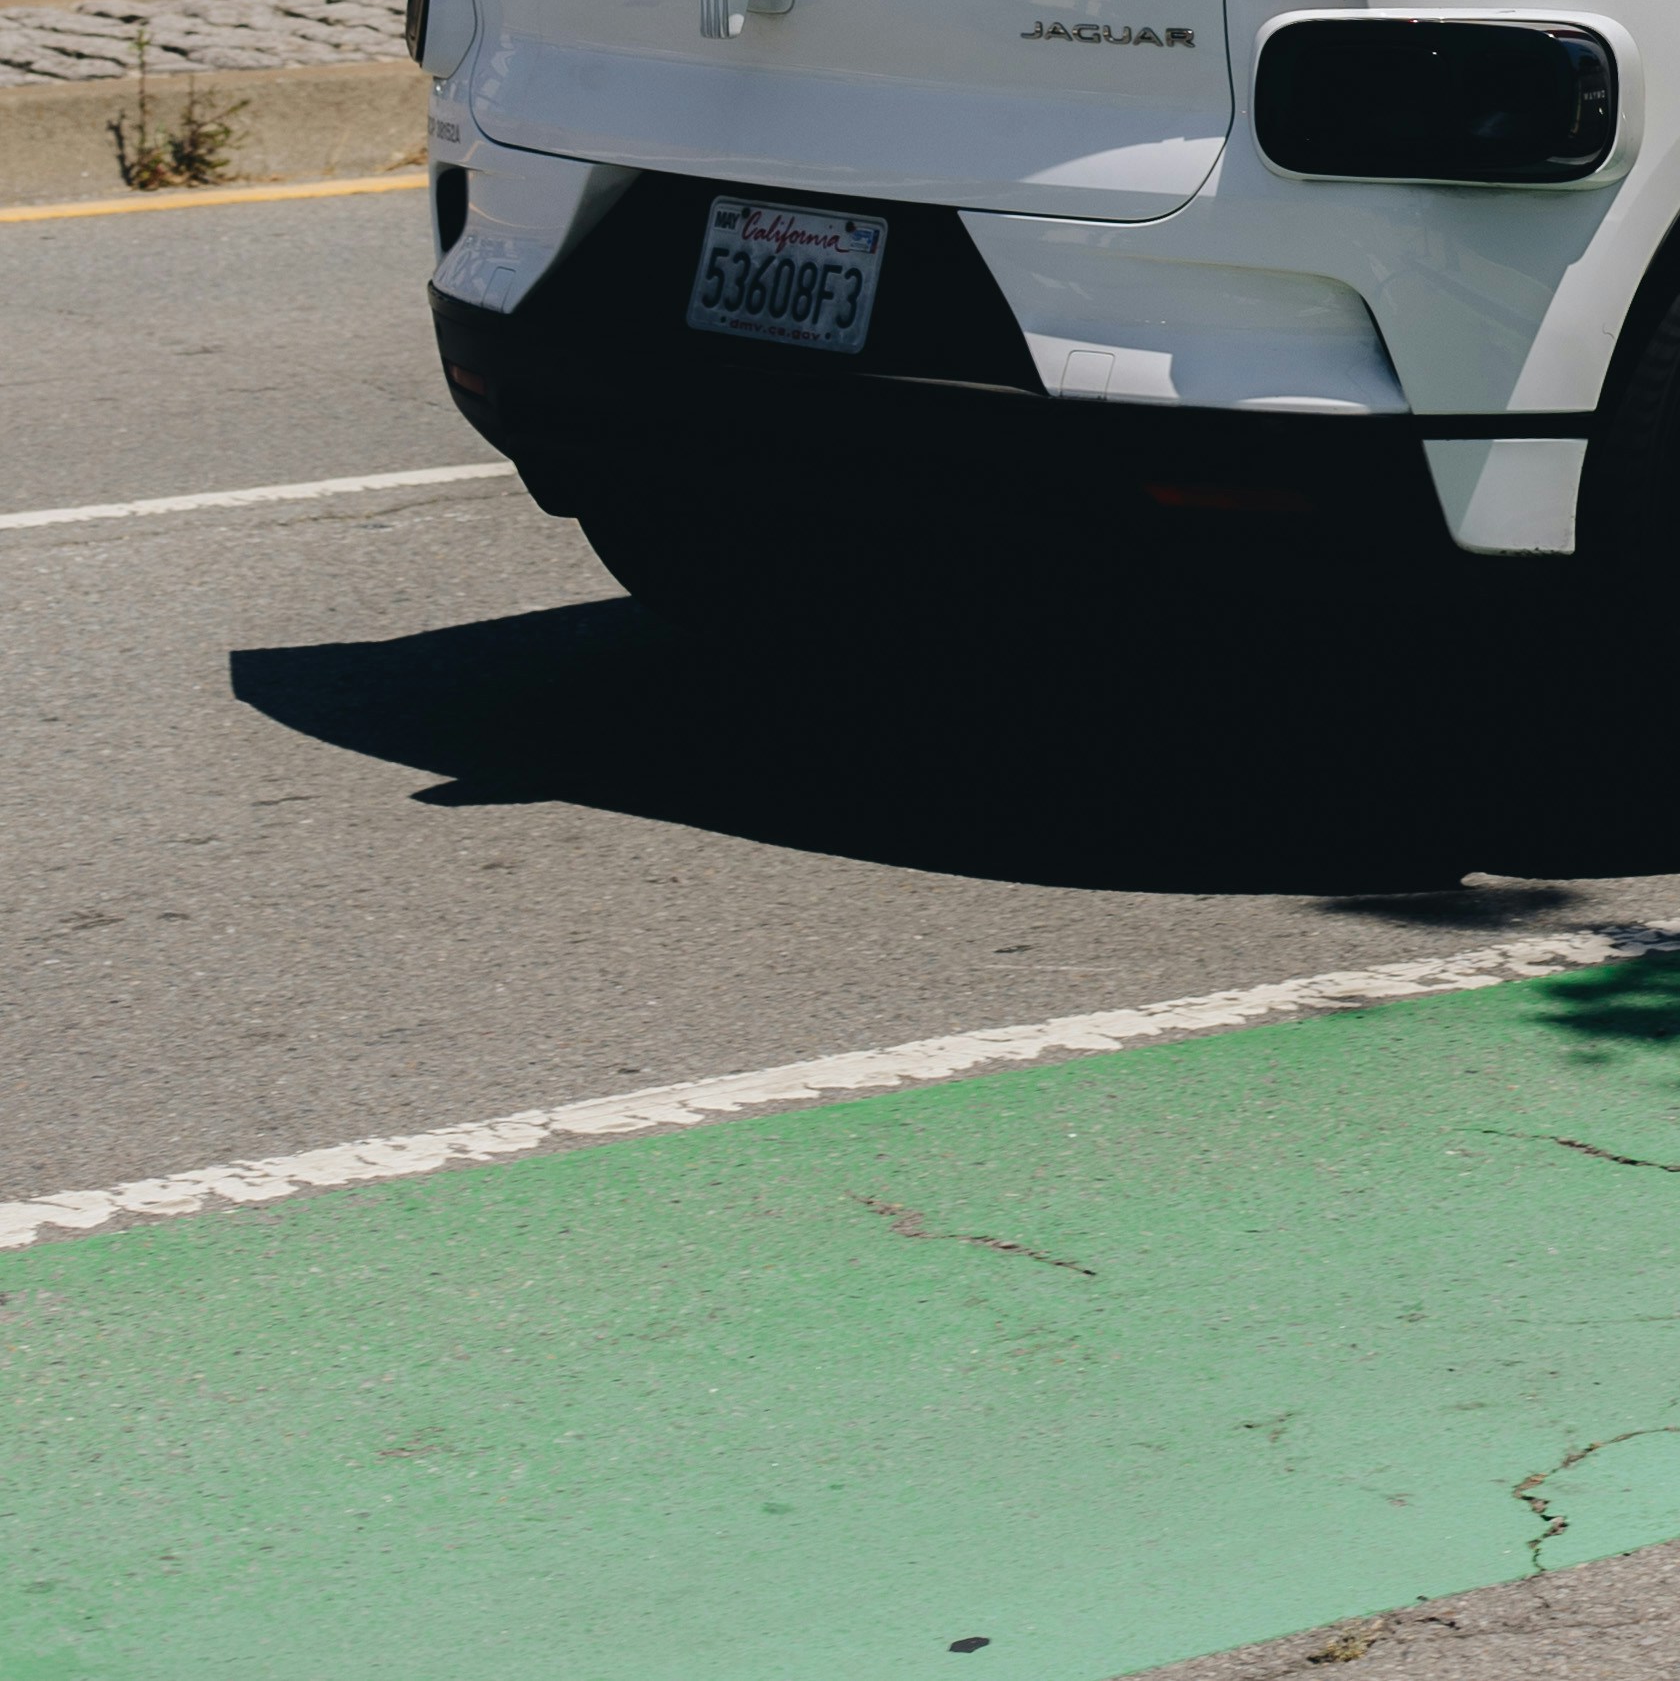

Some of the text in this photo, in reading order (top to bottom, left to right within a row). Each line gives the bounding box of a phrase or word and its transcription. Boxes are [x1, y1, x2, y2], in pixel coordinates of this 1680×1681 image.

[1020, 20, 1196, 48] JAGUAR
[714, 210, 850, 254] MAY California
[702, 246, 863, 329] 53608F3
[729, 318, 821, 341] dmv.ca.gov
